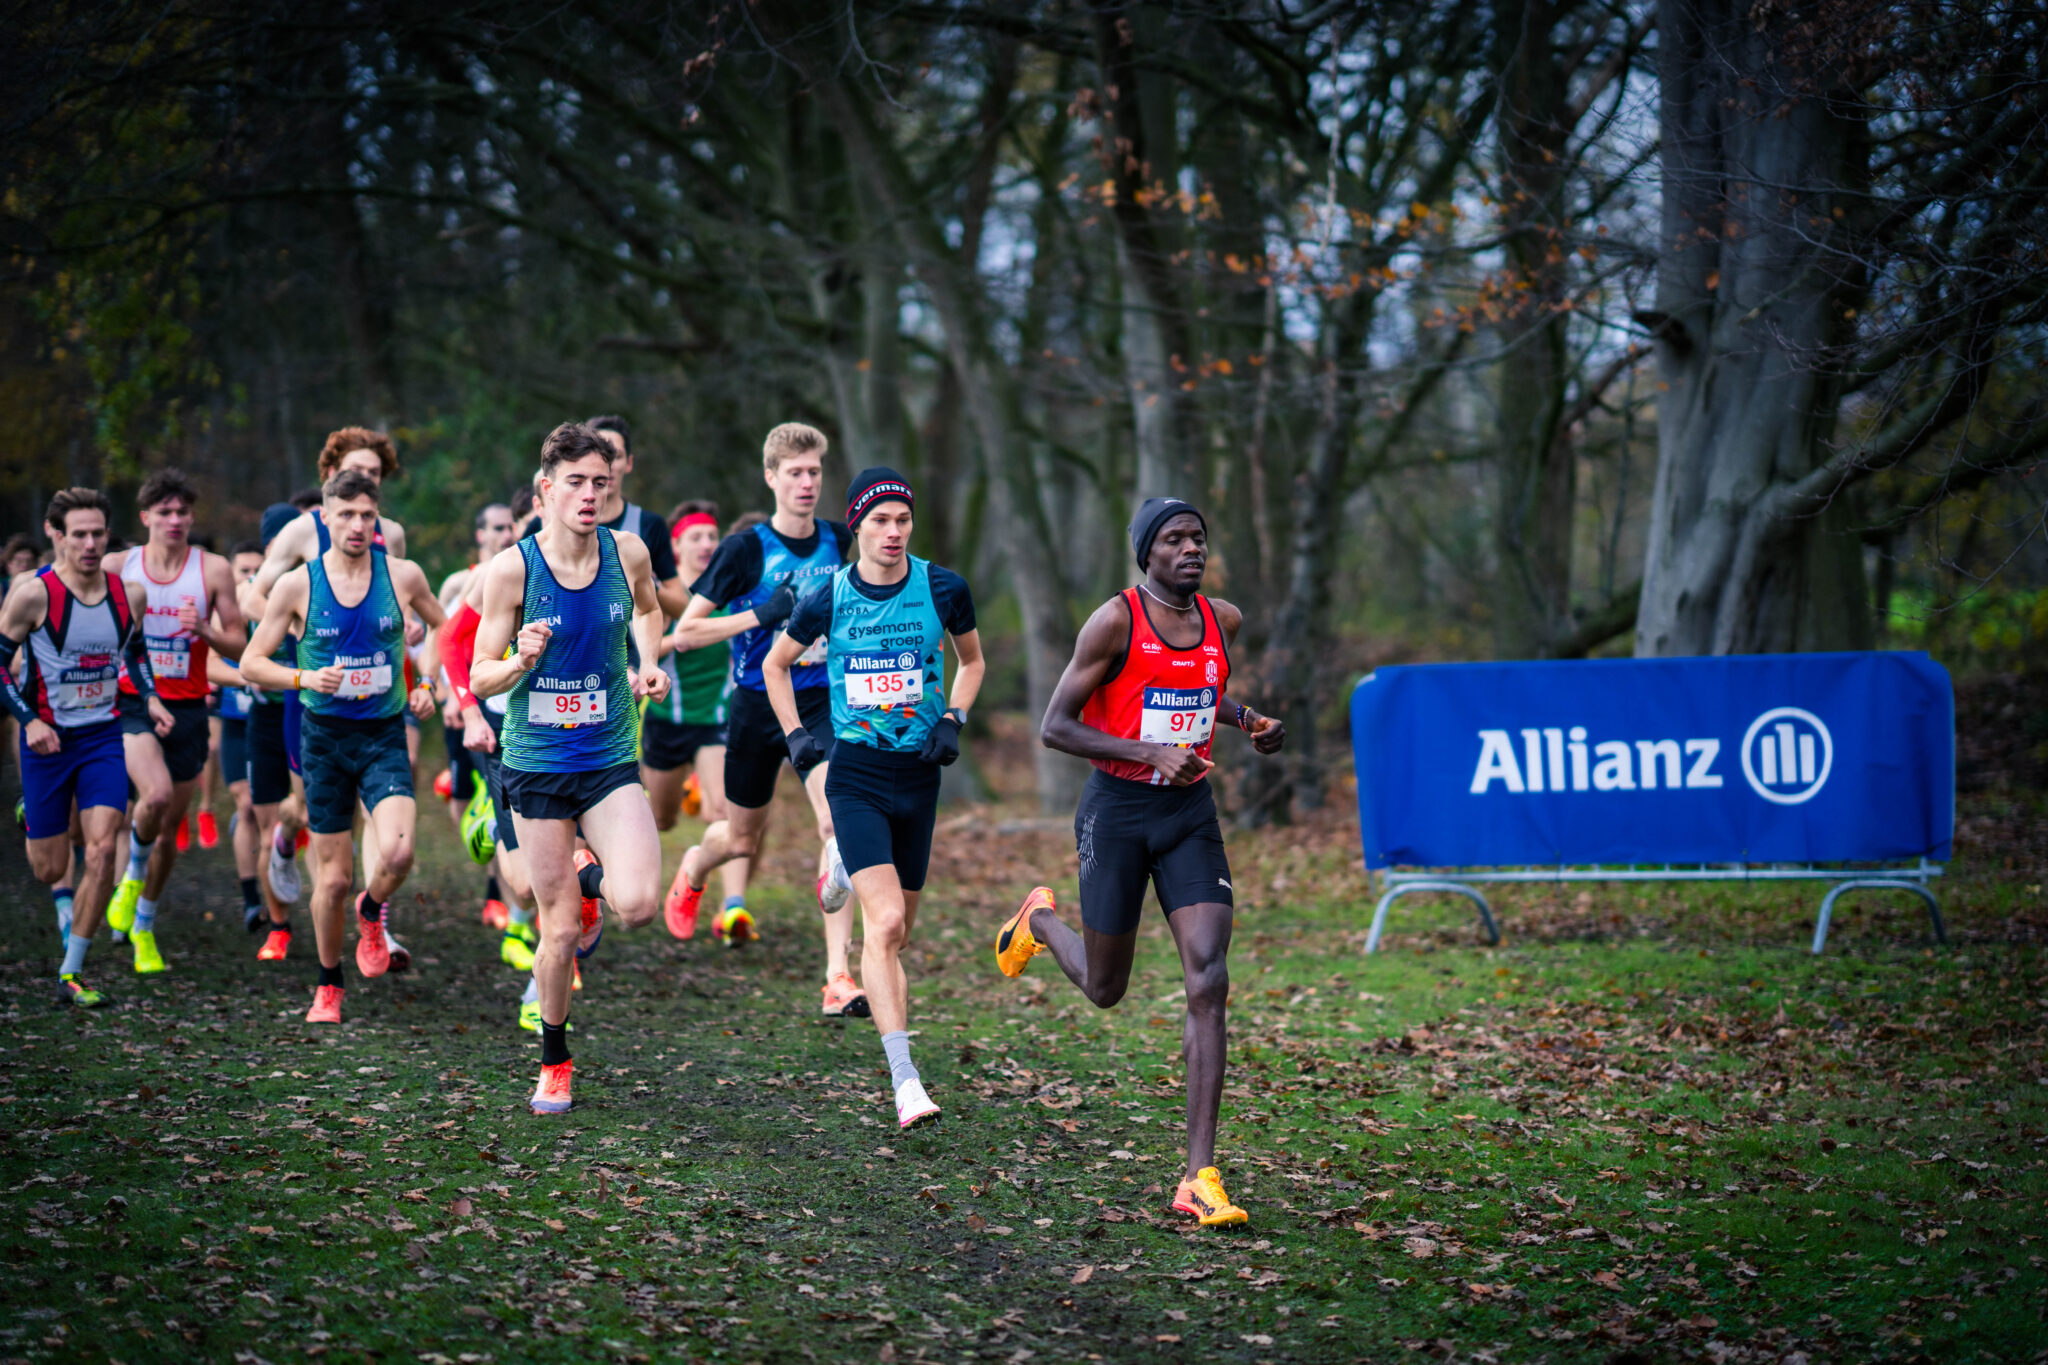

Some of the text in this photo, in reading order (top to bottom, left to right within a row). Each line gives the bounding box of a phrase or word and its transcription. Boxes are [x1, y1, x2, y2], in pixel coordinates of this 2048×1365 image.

[848, 621, 924, 640] gysemans
[880, 634, 925, 652] groep
[333, 654, 372, 668] Allianz
[849, 657, 896, 671] Allianz
[65, 671, 101, 682] Allianz
[350, 669, 372, 687] 62
[535, 676, 583, 690] Allianz
[864, 673, 904, 694] 135
[76, 681, 103, 699] 153
[555, 694, 582, 713] 95
[1150, 692, 1199, 707] Allianz
[1170, 712, 1197, 732] 97
[1469, 726, 1724, 795] Allianz
